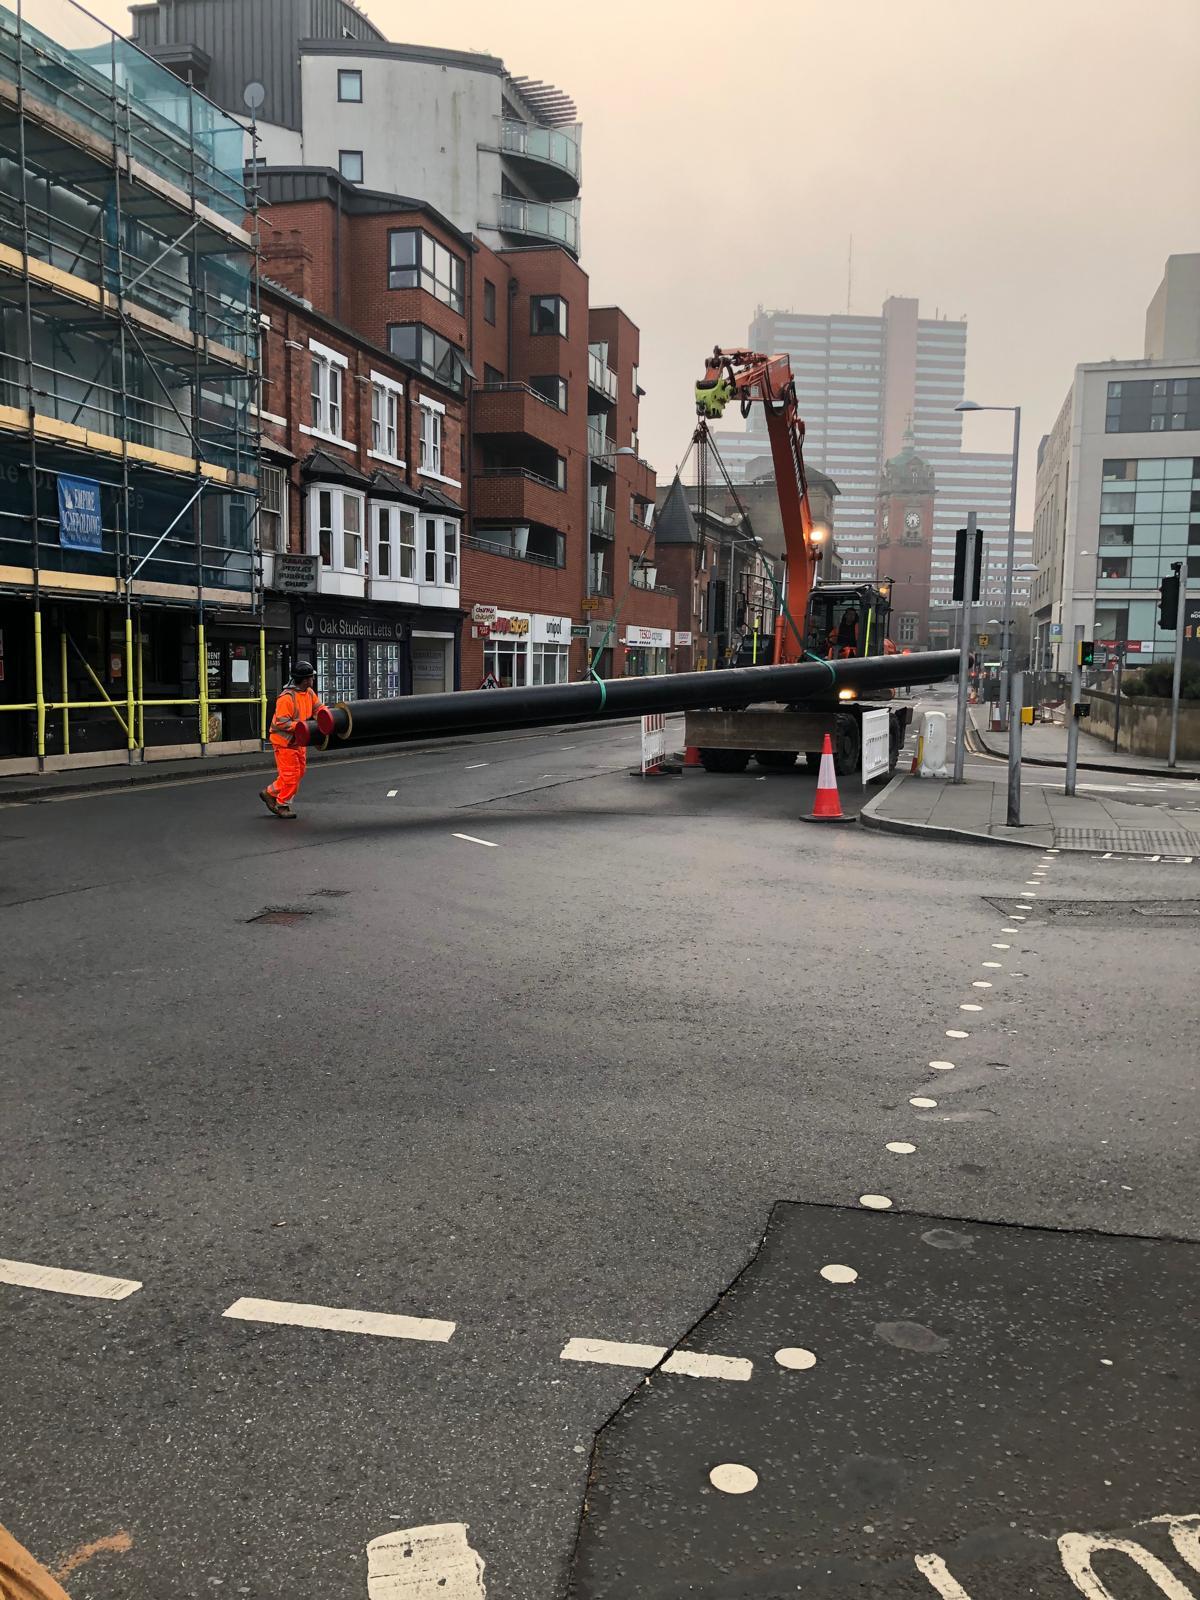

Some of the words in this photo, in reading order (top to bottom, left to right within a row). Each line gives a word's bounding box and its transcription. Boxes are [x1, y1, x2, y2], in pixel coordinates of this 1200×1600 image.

[74, 489, 95, 511] EMPIRE
[319, 617, 338, 635] Oak
[339, 618, 373, 637] Student
[373, 622, 392, 638] Letts
[546, 618, 563, 638] unipol
